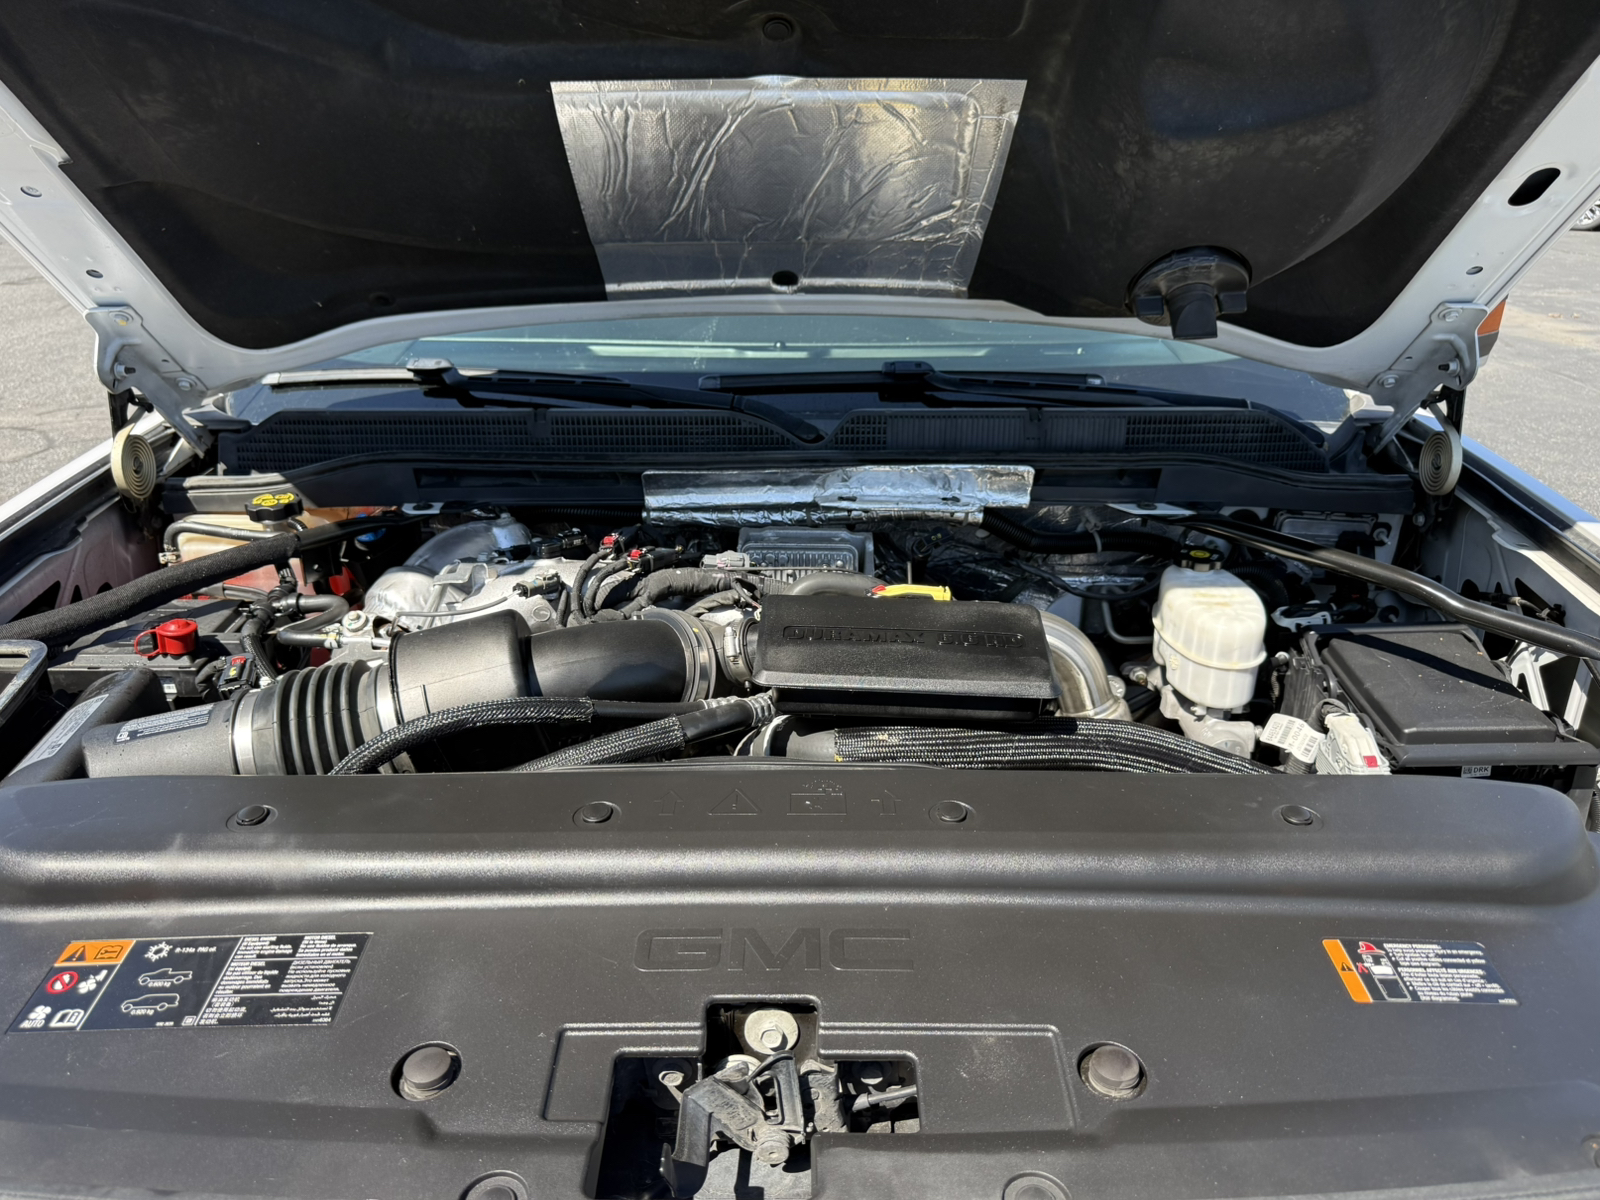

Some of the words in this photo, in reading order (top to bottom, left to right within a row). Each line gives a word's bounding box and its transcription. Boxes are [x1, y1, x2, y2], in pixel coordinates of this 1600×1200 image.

[786, 628, 925, 644] DURAMAX
[983, 633, 1026, 648] HD
[633, 927, 914, 972] GMC
[19, 1020, 45, 1028] AUTO
